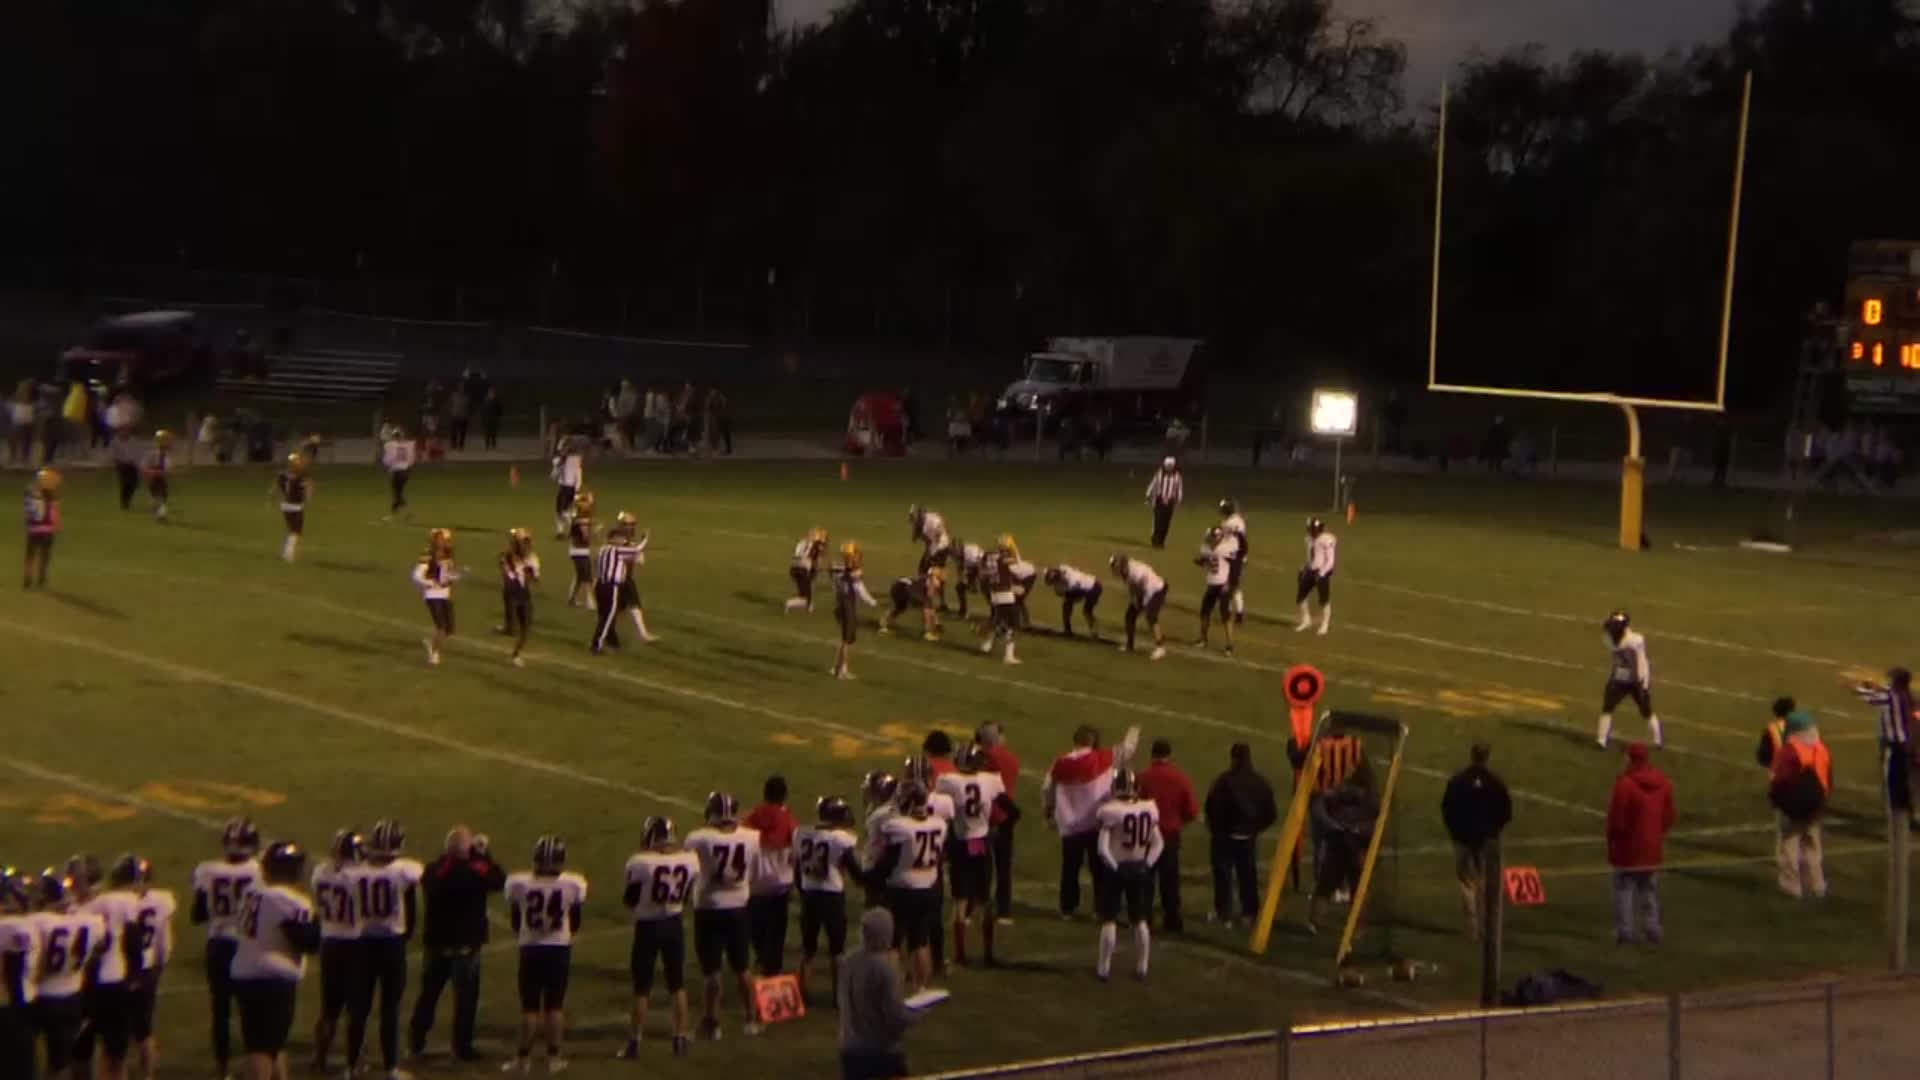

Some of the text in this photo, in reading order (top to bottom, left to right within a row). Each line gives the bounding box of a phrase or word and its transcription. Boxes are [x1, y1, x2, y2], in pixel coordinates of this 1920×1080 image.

[965, 784, 981, 817] 2
[1122, 811, 1151, 849] 90
[712, 843, 746, 882] 74
[911, 830, 940, 869] 75
[359, 877, 391, 918] 10
[652, 865, 688, 903] 63
[1510, 871, 1540, 902] 20
[526, 889, 563, 932] 24
